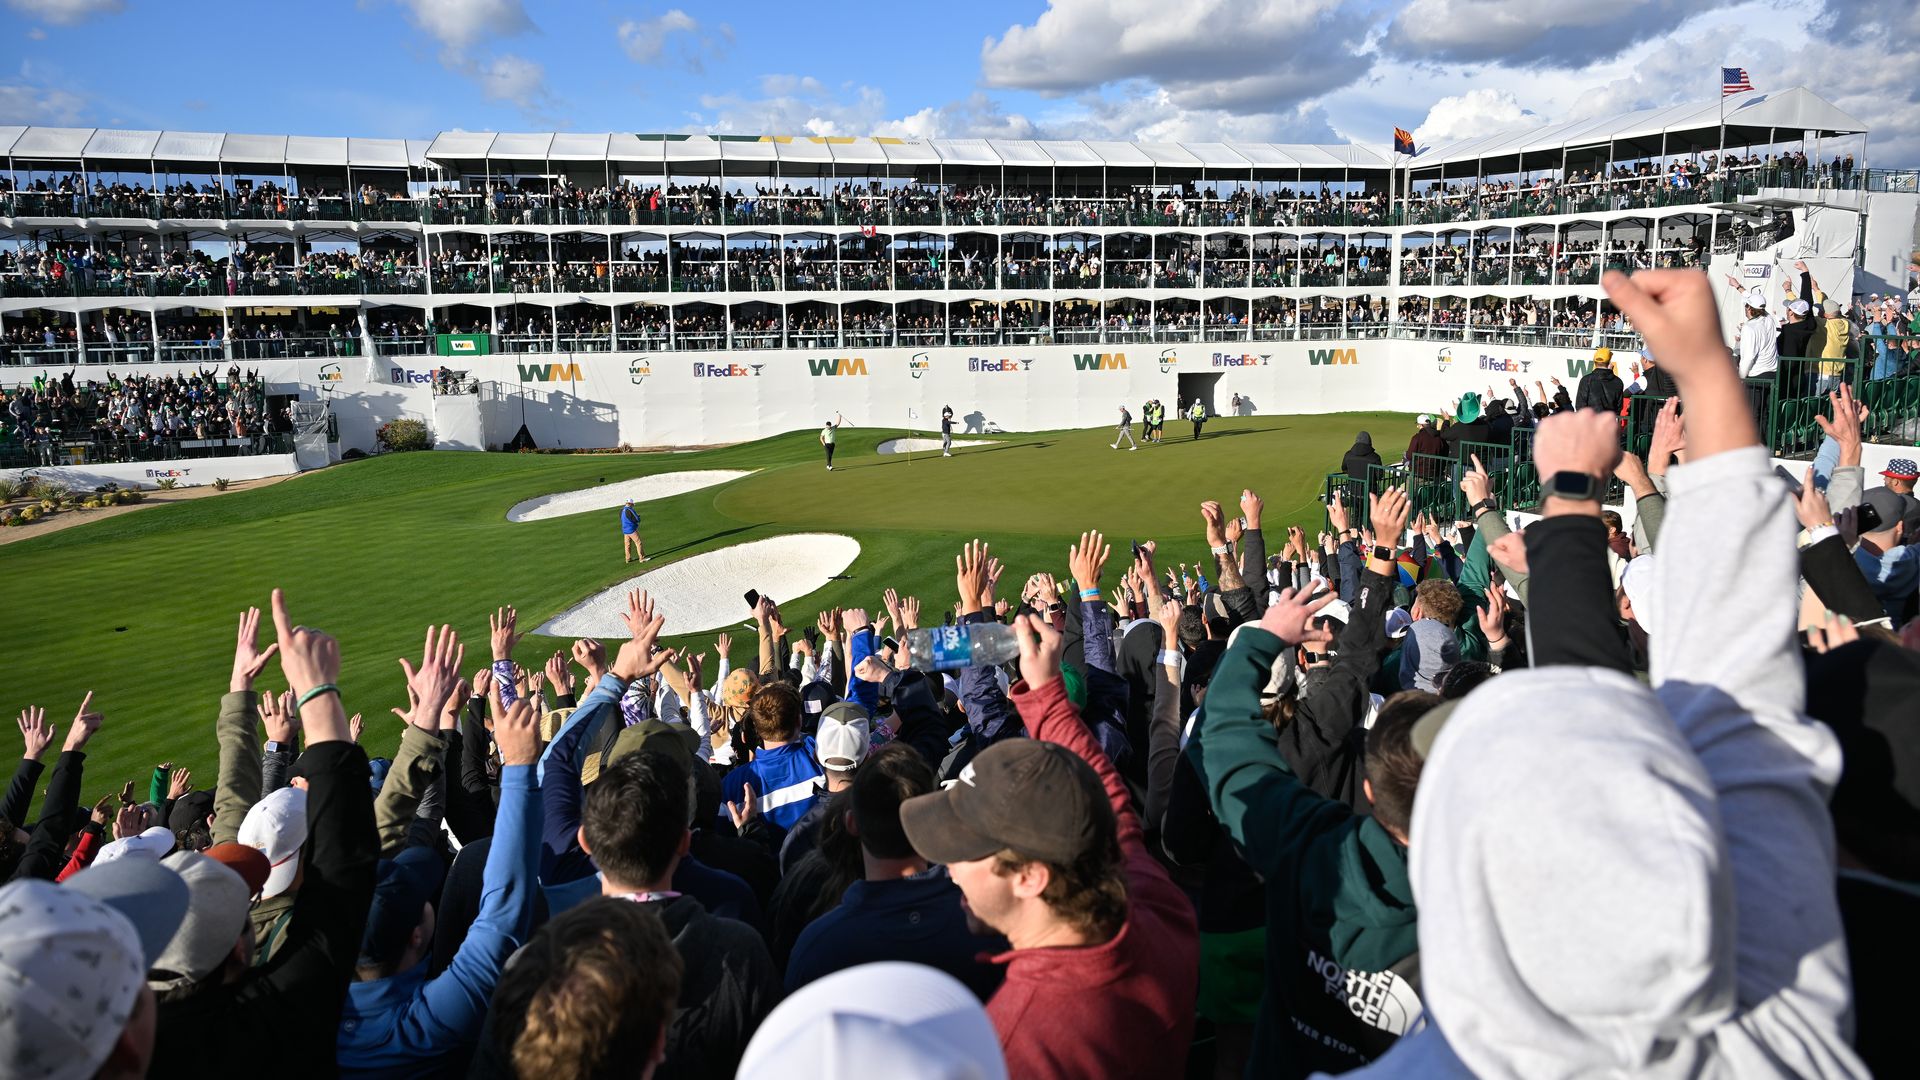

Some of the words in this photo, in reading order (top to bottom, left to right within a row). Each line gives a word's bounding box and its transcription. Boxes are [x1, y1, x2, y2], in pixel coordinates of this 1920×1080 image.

[981, 359, 1018, 371] FedEx
[1073, 353, 1128, 371] WM
[1223, 354, 1258, 366] FedEx
[1308, 348, 1358, 366] WM
[1488, 357, 1519, 373] FedEx
[517, 364, 583, 382] WM
[707, 364, 748, 377] FedEx
[808, 358, 868, 377] WM
[155, 469, 182, 478] FedEx
[1307, 951, 1388, 1008] NORTH
[1325, 981, 1380, 1027] FACE
[1323, 1035, 1356, 1054] STOP
